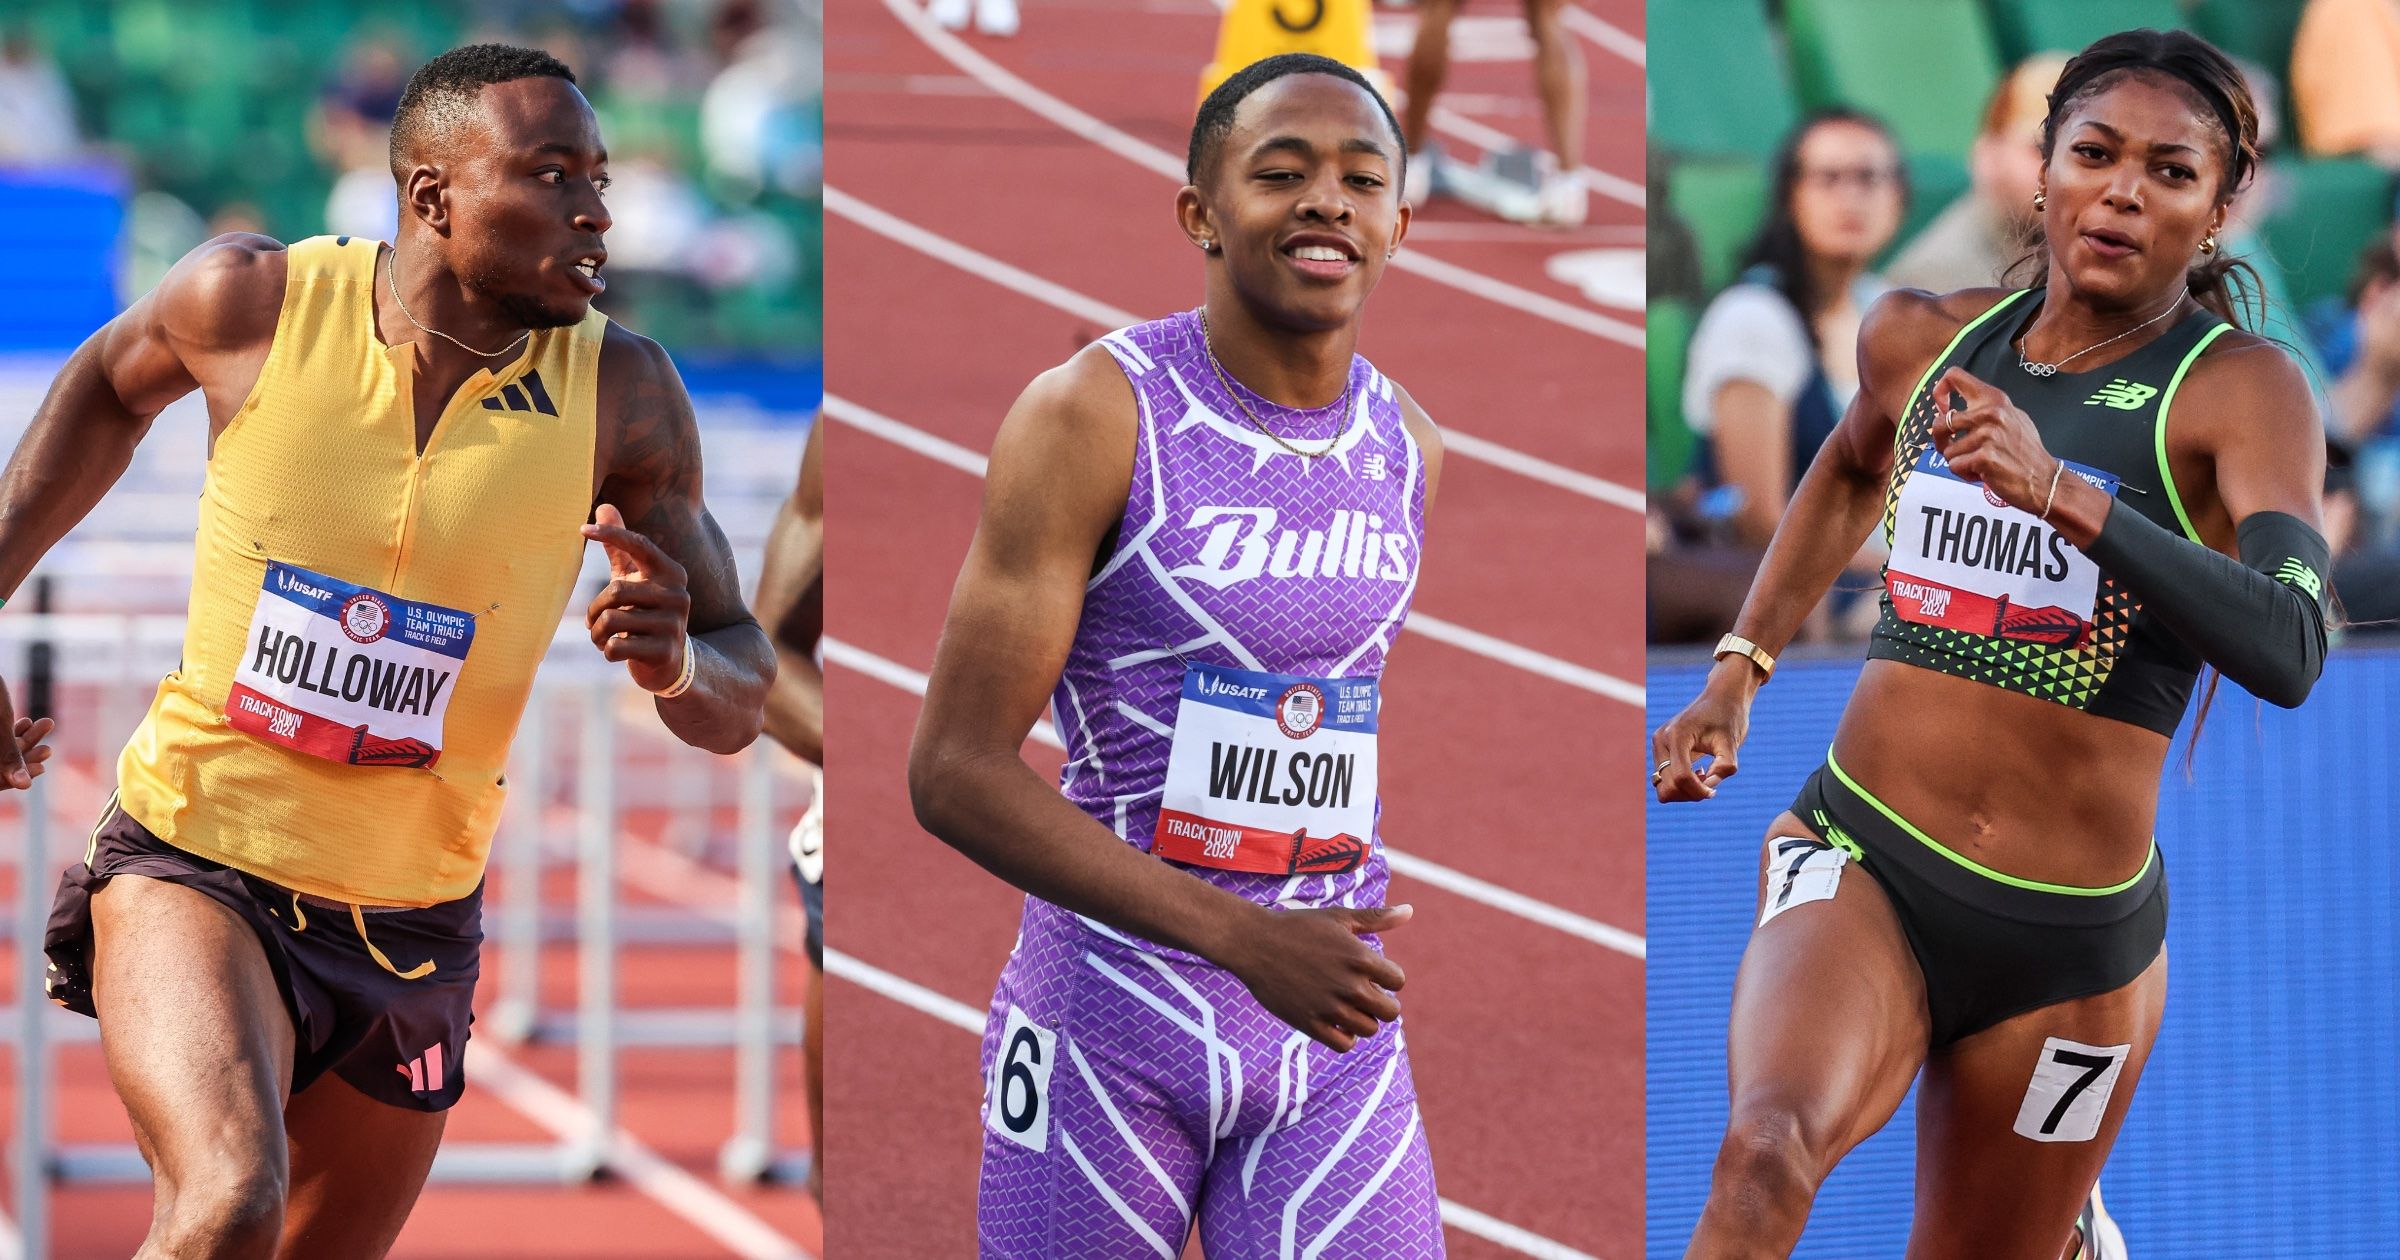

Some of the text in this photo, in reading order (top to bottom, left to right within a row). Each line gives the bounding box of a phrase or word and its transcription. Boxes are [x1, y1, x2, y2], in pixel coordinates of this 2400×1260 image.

[1168, 505, 1409, 591] Bullis
[1920, 505, 2071, 582] THOMAS
[294, 583, 333, 601] USATF
[1892, 580, 1951, 603] TRACKTOWN
[349, 594, 388, 612] UNITED STATES
[1919, 600, 1946, 618] 2024
[407, 606, 465, 628] U.S. OLYMPIC
[365, 633, 380, 642] TEAM
[404, 629, 447, 646] TRACK & FIELD
[406, 617, 464, 640] TEAM TRIALS
[252, 625, 450, 717] HOLLOWAY
[1218, 682, 1268, 701] USATF
[1285, 684, 1323, 701] UNITED STATES
[239, 695, 303, 729] TRACKTOWN
[1338, 700, 1355, 713] TEAM
[268, 718, 296, 739] 2024
[1302, 726, 1316, 738] TEAM
[1209, 741, 1354, 809] WILSON
[1167, 819, 1242, 846] TRACKTOWN
[1203, 841, 1235, 860] 2024
[1775, 839, 1831, 909] 7
[1001, 1026, 1040, 1133] 6
[2039, 1049, 2114, 1134] 7
